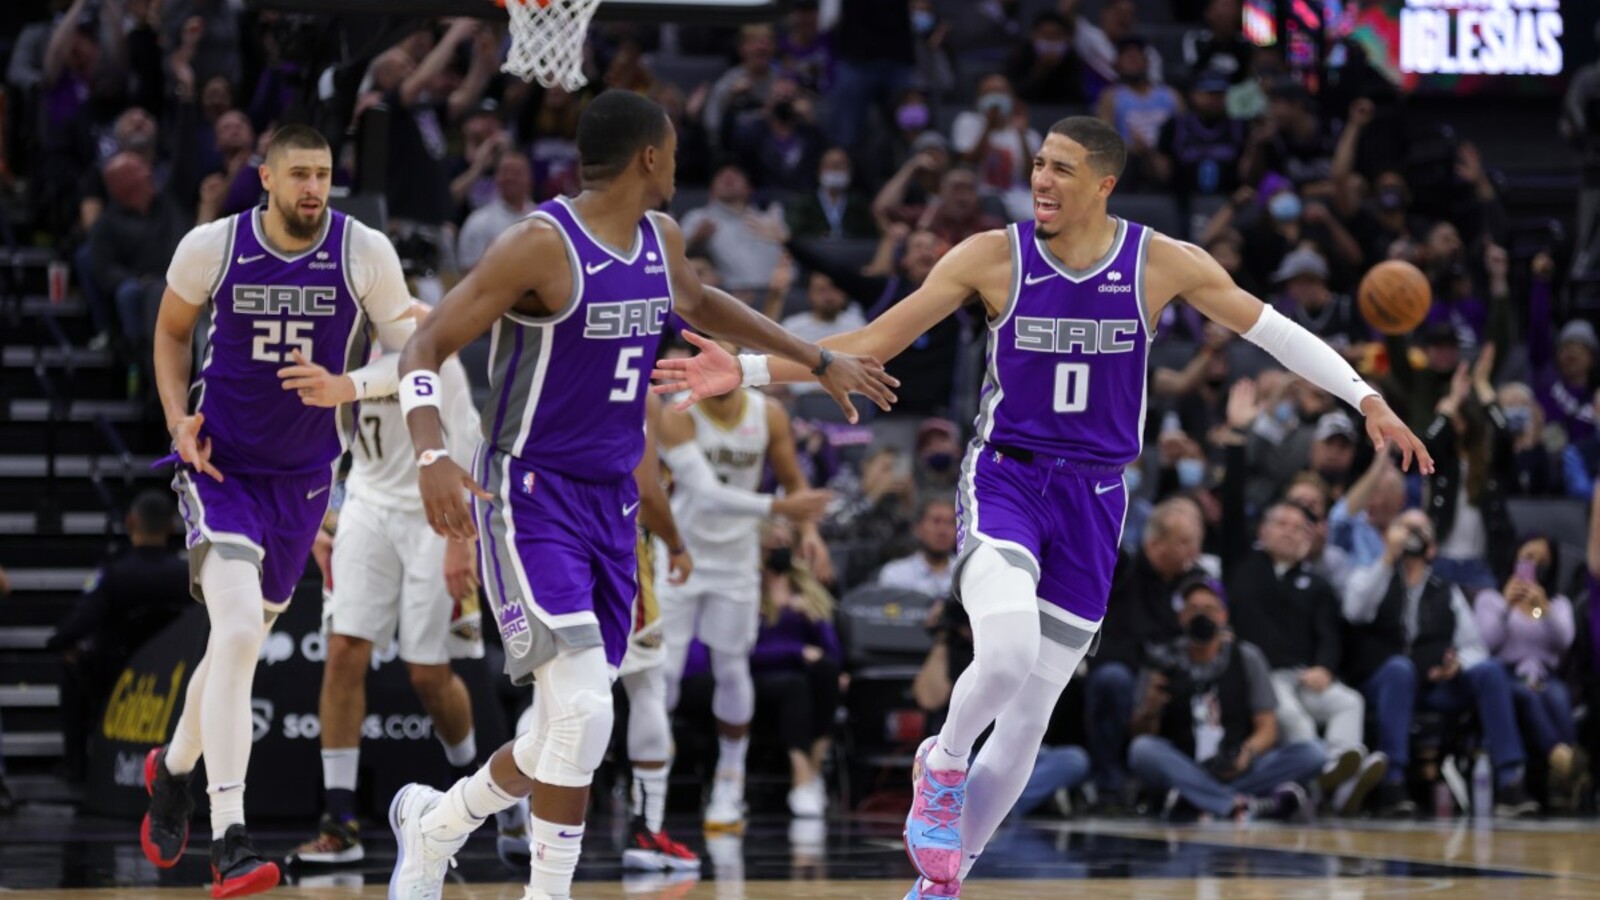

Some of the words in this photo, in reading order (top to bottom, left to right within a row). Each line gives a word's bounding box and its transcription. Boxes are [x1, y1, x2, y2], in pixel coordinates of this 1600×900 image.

[1400, 9, 1563, 75] IGLESIAS
[308, 261, 337, 271] dialpad
[233, 284, 336, 316] SAC
[1098, 284, 1131, 294] dialpad
[583, 297, 670, 339] SAC
[1015, 316, 1138, 354] SAC
[252, 320, 314, 362] 25
[413, 375, 433, 396] 5
[609, 346, 644, 402] 5
[1053, 362, 1089, 412] 0
